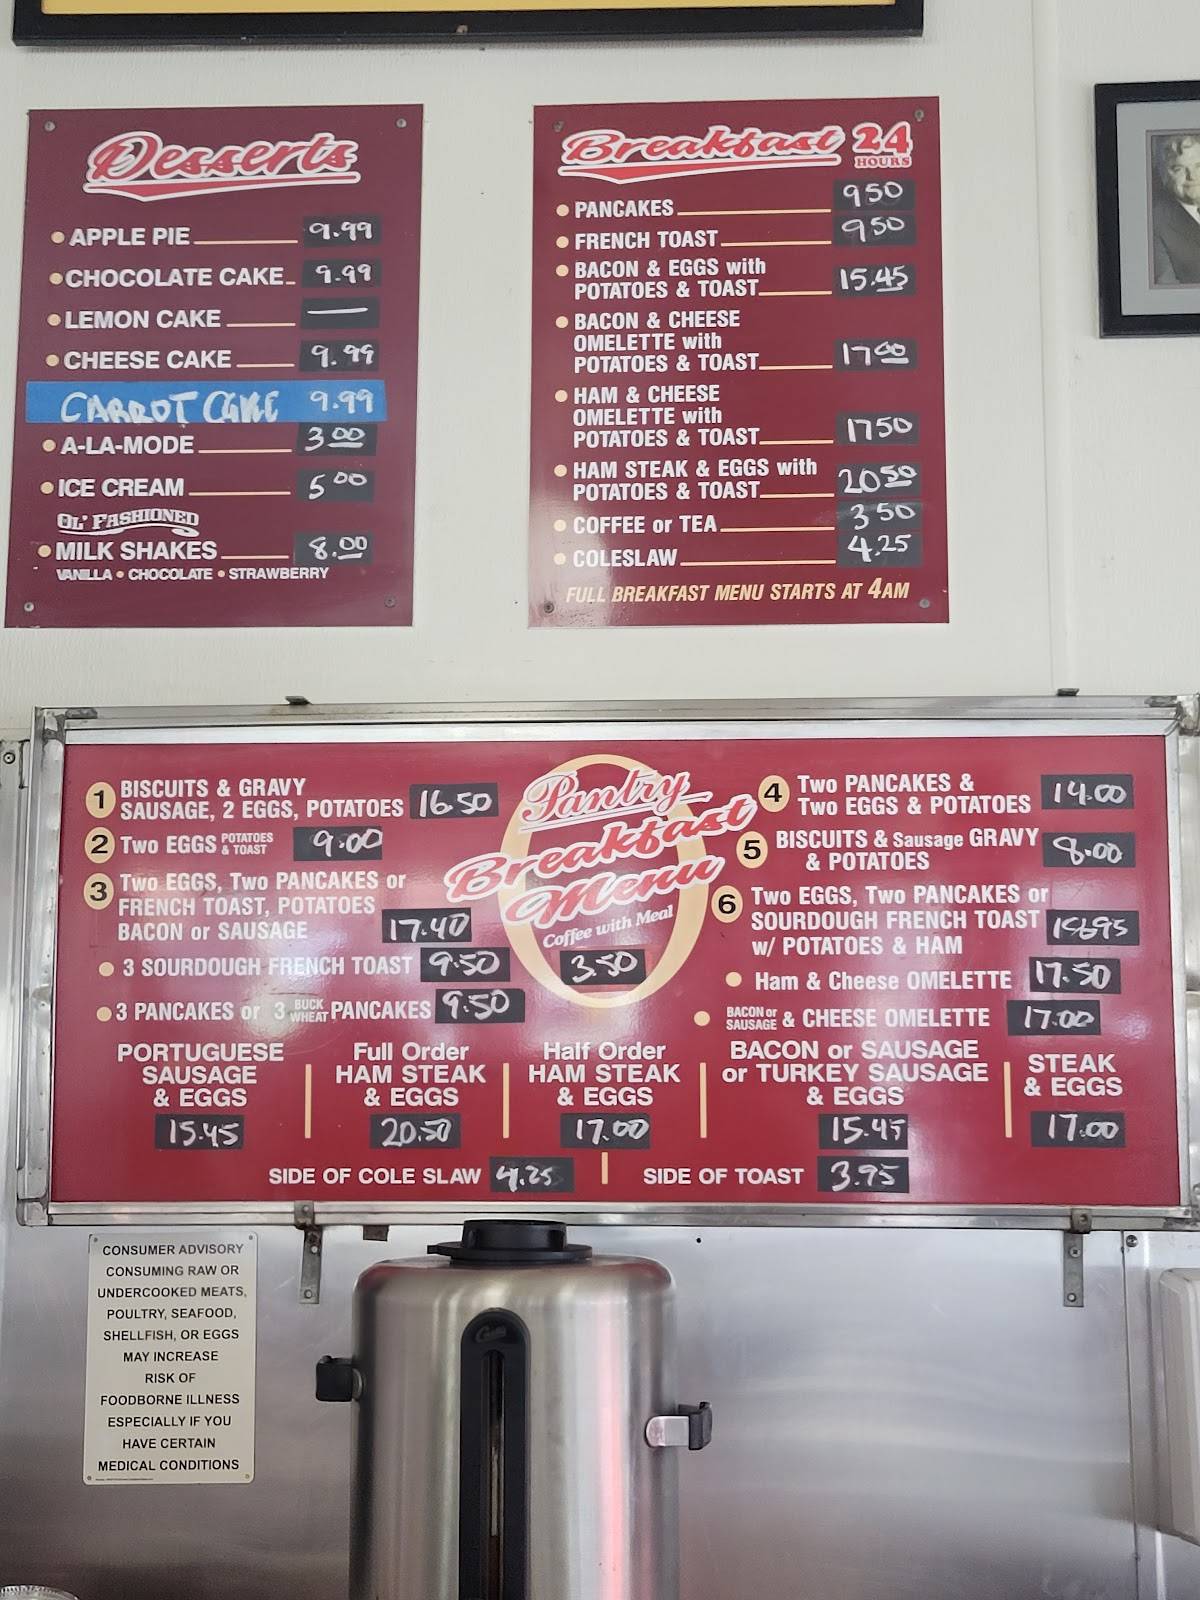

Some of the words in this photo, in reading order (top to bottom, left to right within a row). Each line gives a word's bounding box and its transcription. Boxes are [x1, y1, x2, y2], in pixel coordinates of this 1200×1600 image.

[561, 125, 845, 165] Breakfast
[853, 121, 912, 154] 24
[86, 131, 359, 184] Desserts
[854, 155, 911, 169] HOURS
[575, 200, 674, 218] PANCAKES
[69, 228, 146, 246] APPLE
[153, 227, 190, 245] PIE
[309, 221, 372, 241] 9.99
[575, 232, 650, 250] FRENCH
[658, 230, 718, 248] TOAST
[65, 268, 212, 288] CHOCOLATE
[219, 267, 284, 286] CAKE
[315, 264, 371, 284] 9.99
[575, 260, 639, 279] BACON
[647, 260, 660, 277] &
[668, 258, 719, 277] EGGS
[726, 258, 766, 275] with
[840, 265, 909, 292] 15.45
[575, 281, 668, 300] POTATOES
[677, 280, 690, 298] &
[698, 279, 758, 297] TOAST
[65, 310, 149, 330] LEMON
[157, 309, 221, 328] CAKE
[64, 351, 159, 370] CHEESE
[166, 350, 231, 368] CAKE
[311, 344, 374, 368] 9.99
[61, 391, 199, 423] CARROT
[310, 389, 374, 413] 9.99
[574, 408, 675, 426] OMELETTE
[682, 408, 722, 424] with
[60, 436, 194, 455] A-LA-MODE
[574, 462, 618, 479] HAM
[625, 461, 688, 478] STEAK
[696, 460, 709, 477] &
[718, 459, 769, 477] EGGS
[777, 458, 817, 475] with
[58, 479, 95, 497] ICE
[101, 478, 184, 497] CREAM
[93, 508, 199, 529] FASHIONED
[574, 517, 646, 535] COFFEE
[653, 519, 672, 533] or
[679, 515, 717, 533] TEA
[56, 542, 113, 561] MILK
[120, 541, 217, 560] SHAKES
[309, 536, 367, 560] 8.00
[573, 549, 678, 567] COLESLAW
[848, 534, 911, 562] 4.25
[57, 569, 112, 581] VANILLA
[128, 568, 213, 580] CHOCOLATE
[229, 567, 328, 579] STRAWBERRY
[565, 587, 606, 603] FULL
[611, 584, 709, 602] BREAKFAST
[714, 583, 763, 601] MENU
[770, 582, 836, 600] STARTS
[842, 582, 863, 599] AT
[868, 578, 910, 599] 4AM
[121, 780, 208, 798] BISCUITS
[217, 780, 230, 797] &
[239, 778, 306, 797] GRAVY
[798, 775, 837, 793] Two
[845, 774, 951, 792] PANCAKES
[960, 774, 974, 791] &
[522, 768, 690, 822] Pantry
[120, 802, 215, 822] SAUSAGE,
[223, 801, 235, 819] 2
[242, 801, 298, 822] EGGS,
[307, 799, 404, 818] POTATOES
[121, 837, 159, 855] Two
[167, 836, 217, 854] EGGS
[221, 833, 273, 844] POTATOES
[444, 793, 757, 902] Breakfast
[776, 831, 867, 849] BISCUITS
[873, 830, 888, 849] &
[893, 833, 963, 851] Sausage
[969, 828, 1039, 847] GRAVY
[221, 845, 229, 855] &
[233, 845, 266, 855] TOAST
[1052, 836, 1122, 864] 8.00
[504, 855, 725, 929] Menu
[752, 887, 791, 906] Two
[799, 886, 857, 907] EGGS,
[866, 886, 905, 904] Two
[914, 885, 1020, 903] PANCAKES
[1028, 887, 1049, 903] or
[543, 926, 592, 948] Coffee
[596, 916, 632, 937] with
[636, 905, 673, 926] Meal
[123, 960, 134, 976] 3
[142, 958, 260, 976] SOURDOUGH
[268, 957, 344, 975] FRENCH
[351, 956, 413, 974] TOAST
[429, 951, 499, 978] 9.50
[571, 952, 638, 983] 3.50
[755, 972, 798, 991] Ham
[806, 972, 821, 990] &
[829, 971, 898, 990] Cheese
[907, 970, 1012, 990] OMELETTE
[1035, 961, 1110, 989] 17.50
[295, 999, 324, 1010] BUCK
[726, 1007, 762, 1018] BACON
[765, 1008, 777, 1018] or
[290, 1011, 329, 1023] WHEAT
[726, 1019, 777, 1030] SAUSAGE
[117, 1043, 284, 1062] PORTUGUESE
[354, 1042, 394, 1061] Full
[402, 1042, 469, 1061] Order
[544, 1042, 591, 1060] Half
[598, 1042, 666, 1060] Order
[142, 1066, 256, 1084] SAUSAGE
[336, 1065, 392, 1083] HAM
[402, 1065, 486, 1083] STEAK
[722, 1065, 746, 1083] or
[756, 1063, 859, 1083] TURKEY
[868, 1062, 989, 1082] SAUSAGE
[269, 1168, 315, 1185] SIDE
[323, 1168, 350, 1185] OF
[358, 1168, 415, 1185] COLE
[423, 1168, 481, 1185] SLAW
[102, 1245, 175, 1256] CONSUMER
[179, 1244, 243, 1254] ADVISORY
[106, 1266, 183, 1276] CONSUMING
[188, 1266, 217, 1276] RAW
[221, 1265, 239, 1275] OR
[98, 1287, 196, 1298] UNDERCOOKED
[201, 1287, 246, 1297] MEATS,
[107, 1308, 166, 1320] POULTRY,
[171, 1308, 236, 1318] SEAFOOD,
[103, 1330, 177, 1341] SHELLFISH,
[180, 1330, 199, 1340] OR
[203, 1329, 239, 1339] EGGS
[124, 1352, 149, 1362] MAY
[154, 1351, 218, 1361] INCREASE
[145, 1373, 174, 1383] RISK
[179, 1373, 196, 1383] OF
[100, 1395, 182, 1406] FOODBORNE
[186, 1394, 239, 1404] ILLNESS
[108, 1417, 186, 1427] ESPECIALLY
[190, 1417, 201, 1426] IF
[205, 1416, 231, 1426] YOU
[123, 1439, 156, 1449] HAVE
[161, 1438, 215, 1448] CERTAIN
[99, 1461, 155, 1471] MEDICAL
[159, 1460, 239, 1470] CONDITIONS
